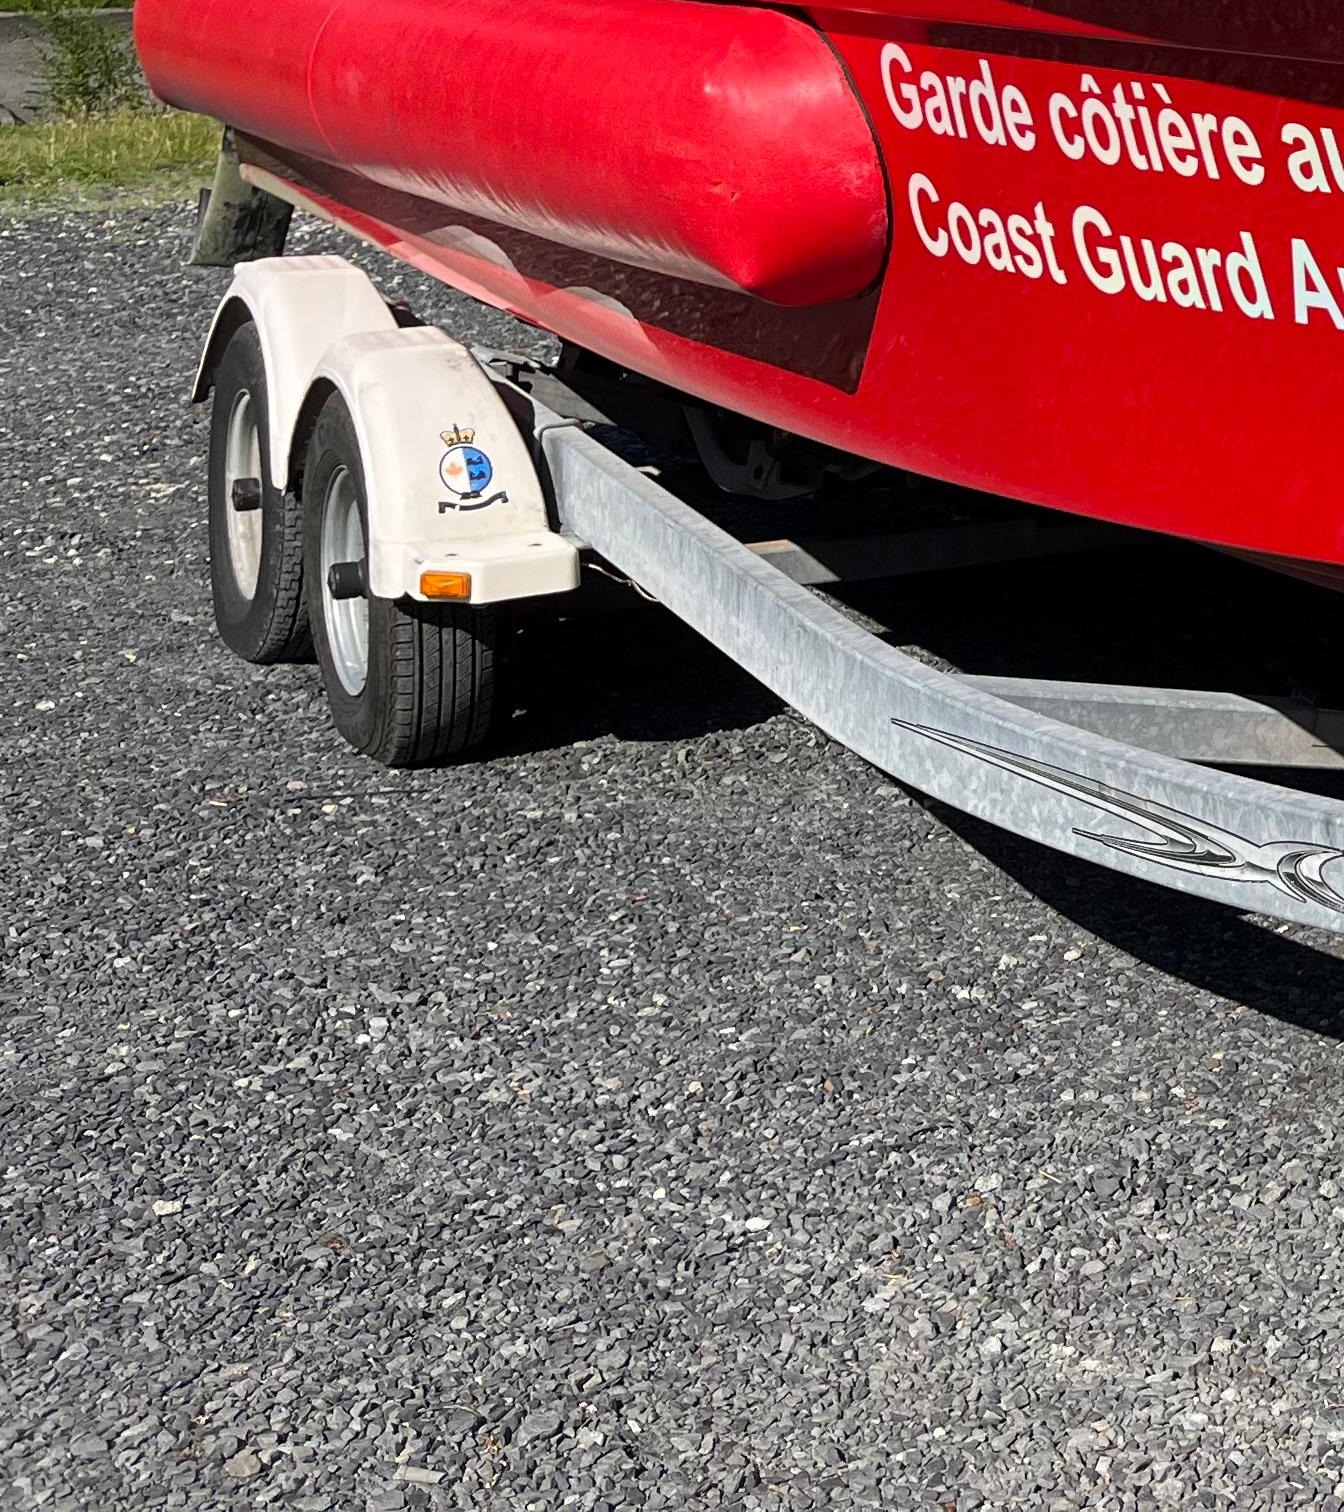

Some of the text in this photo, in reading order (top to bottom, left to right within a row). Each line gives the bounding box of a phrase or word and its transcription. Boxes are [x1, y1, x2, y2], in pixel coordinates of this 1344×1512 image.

[880, 41, 1035, 151] Garde
[1049, 73, 1266, 186] côtière
[906, 172, 1069, 285] Coast
[1072, 205, 1275, 320] Guard
